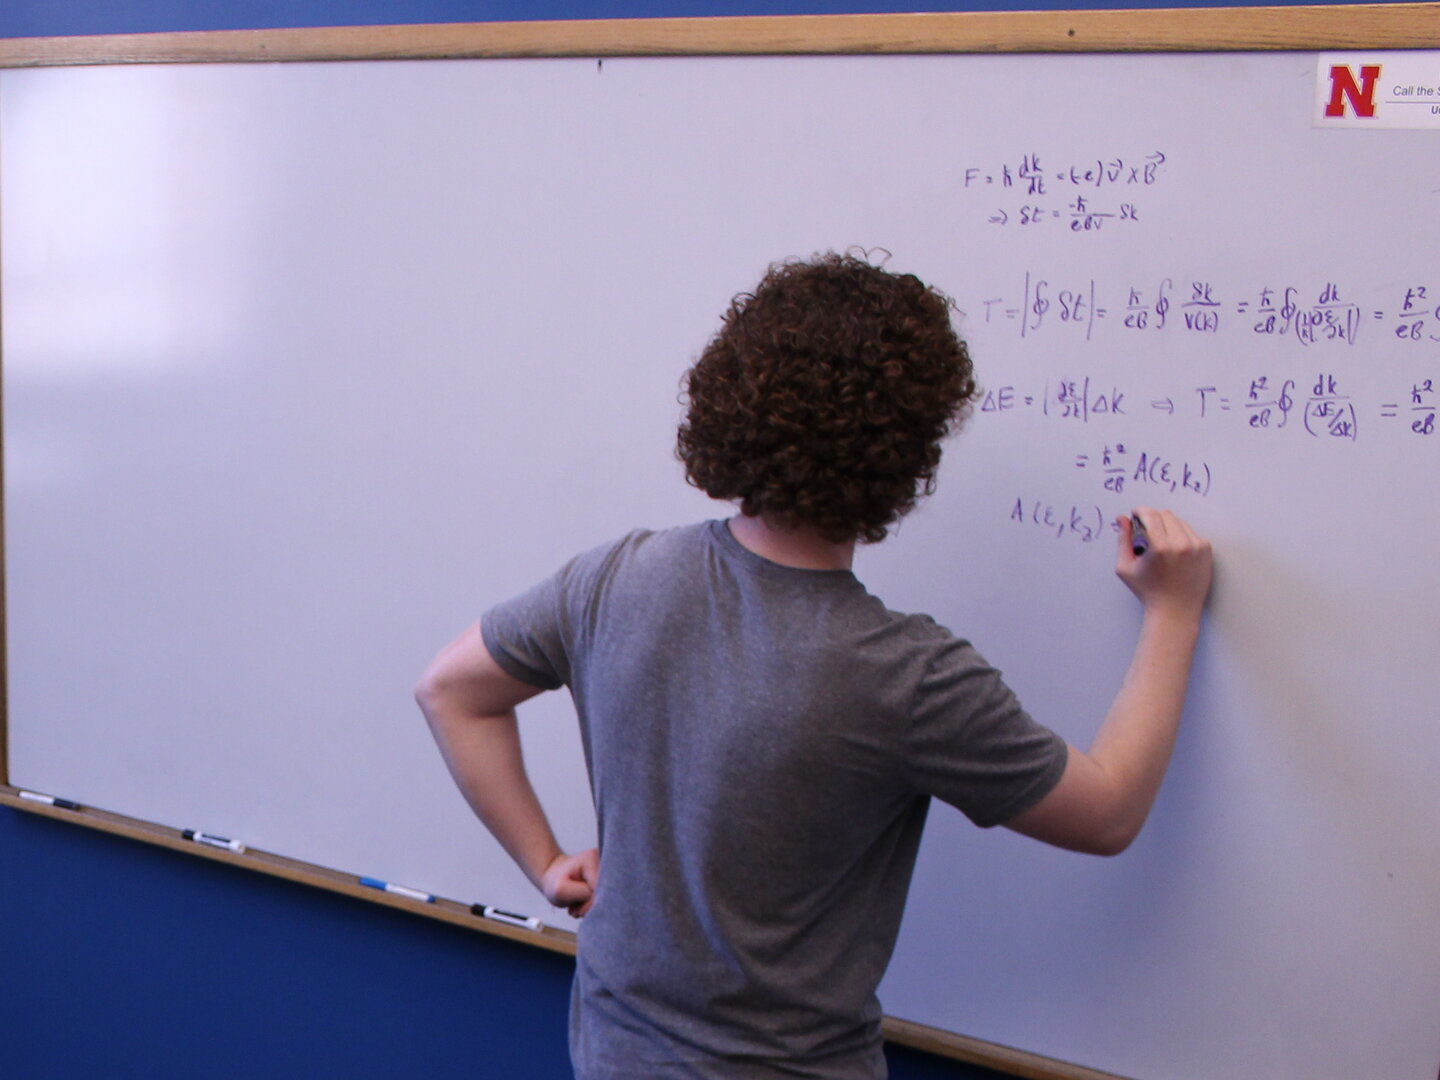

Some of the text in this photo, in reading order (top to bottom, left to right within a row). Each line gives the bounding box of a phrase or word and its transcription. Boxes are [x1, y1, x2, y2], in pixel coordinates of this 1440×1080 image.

[1323, 63, 1382, 119] N
[1392, 85, 1413, 96] Call
[1416, 86, 1434, 96] the
